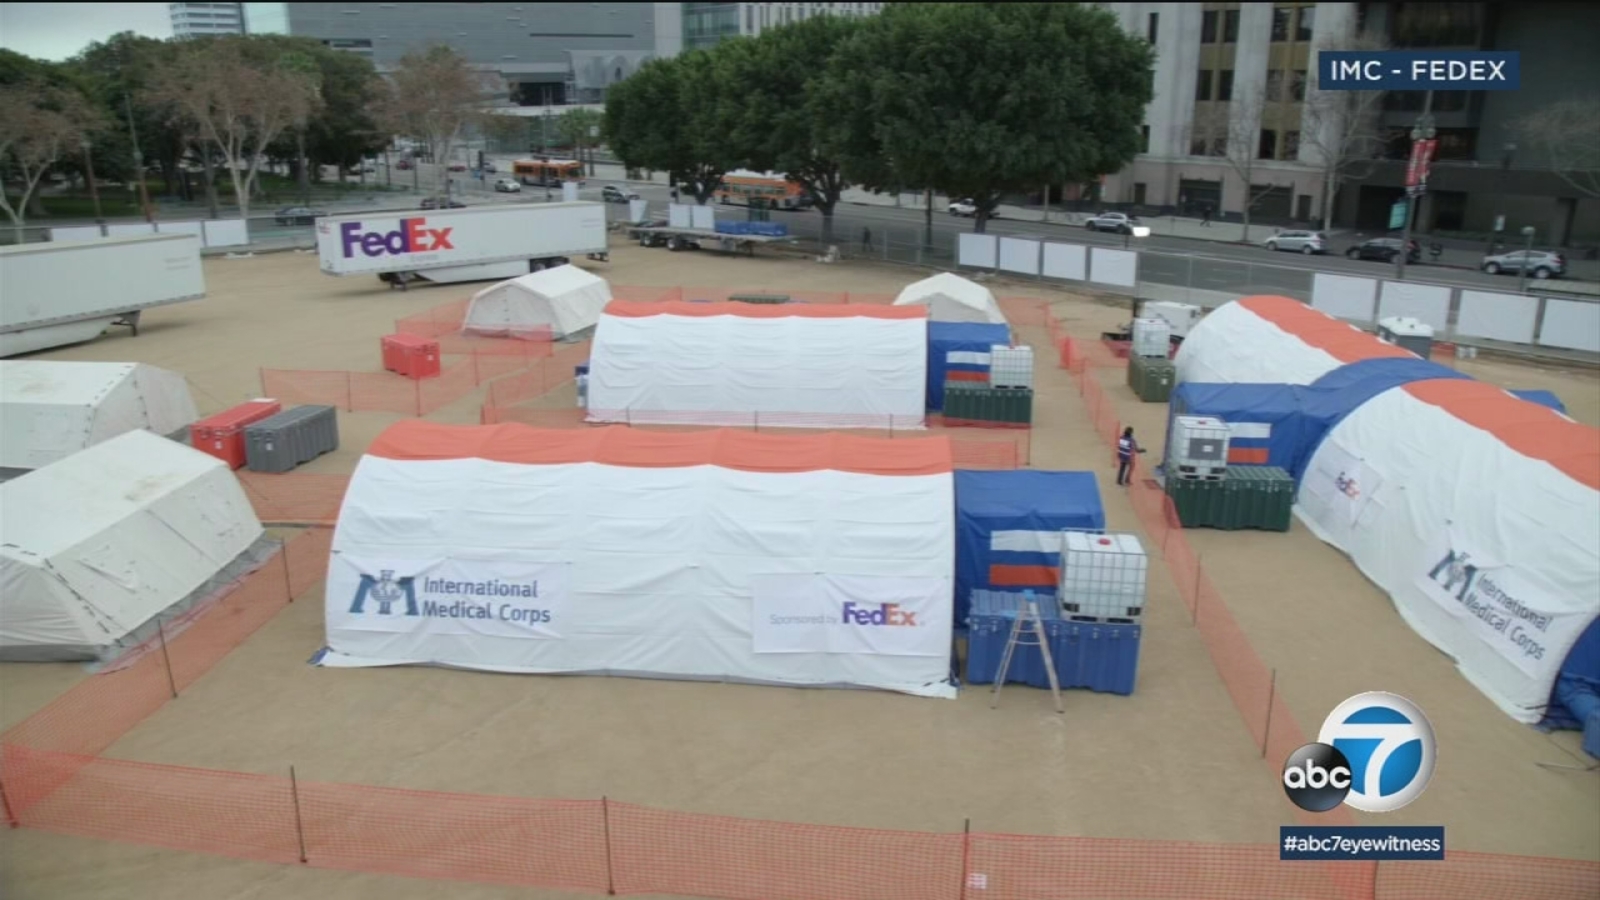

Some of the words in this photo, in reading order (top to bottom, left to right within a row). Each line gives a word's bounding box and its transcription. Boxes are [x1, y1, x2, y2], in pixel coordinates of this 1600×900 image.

[340, 217, 454, 258] FedEx
[424, 577, 538, 598] International
[1478, 573, 1553, 633] International
[422, 600, 492, 620] Medical
[499, 604, 551, 626] Corps
[842, 601, 917, 627] FedEx
[1464, 592, 1512, 635] Medical
[1510, 626, 1546, 660] Corps
